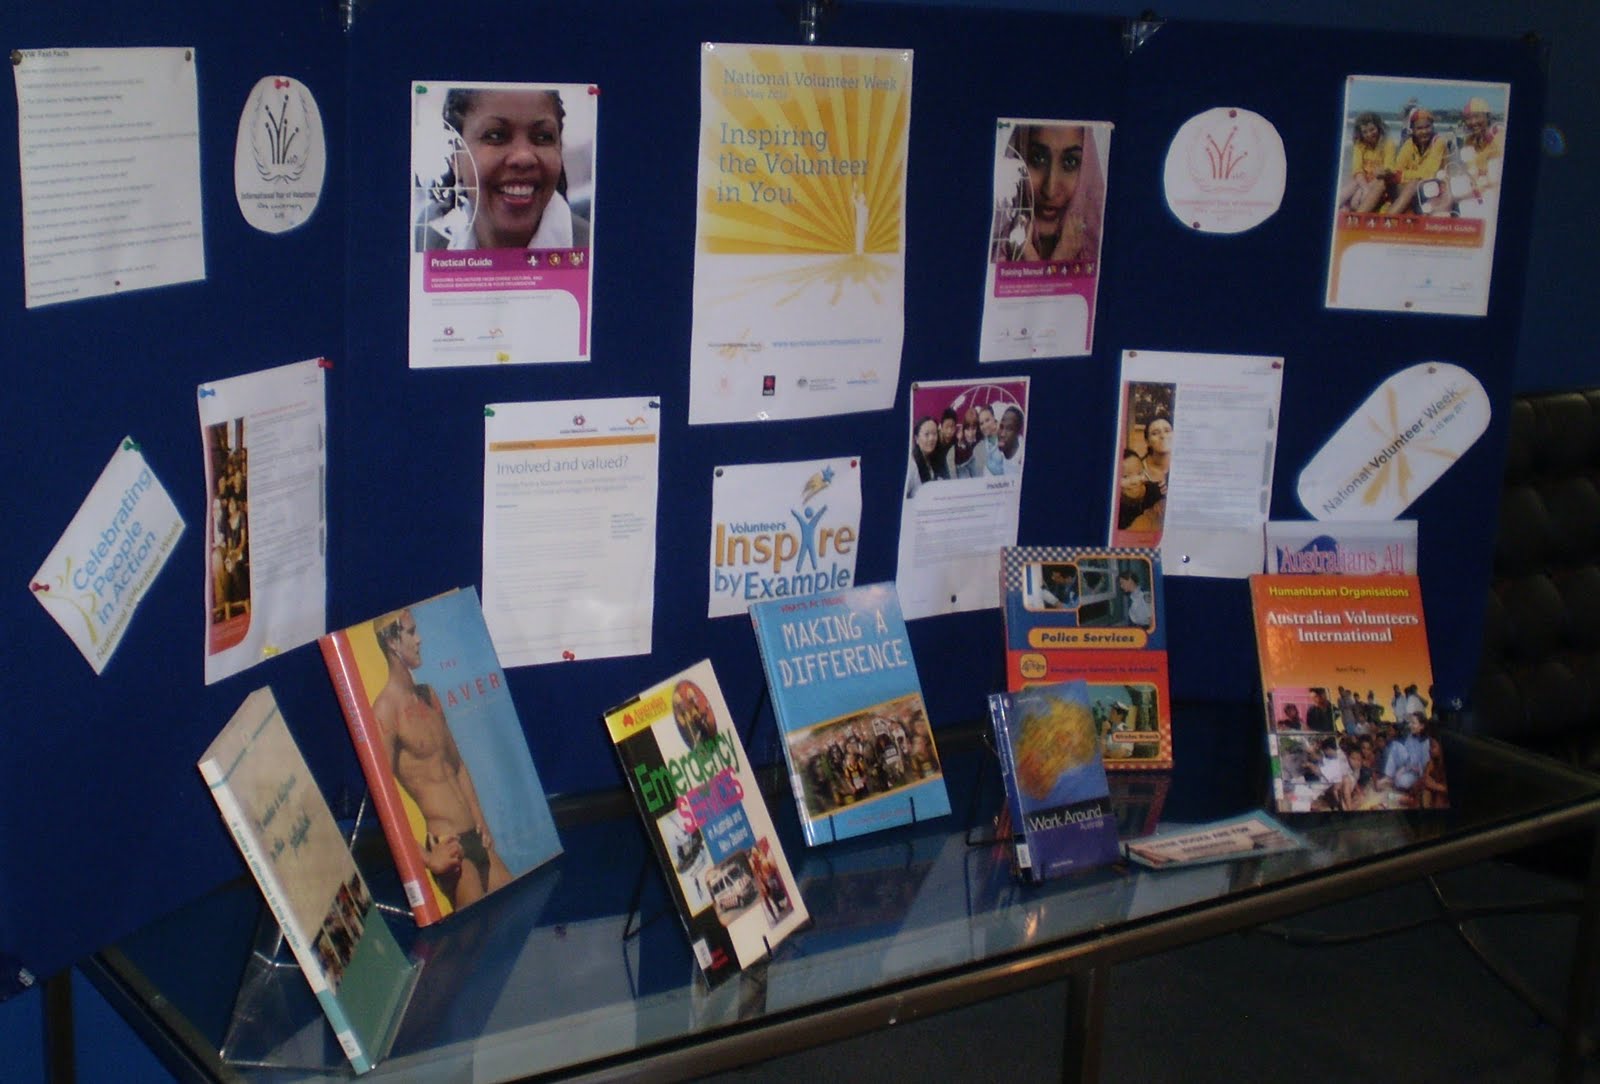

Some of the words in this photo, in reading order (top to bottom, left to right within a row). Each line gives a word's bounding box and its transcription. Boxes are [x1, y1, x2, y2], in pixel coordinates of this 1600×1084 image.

[724, 68, 789, 87] National
[794, 71, 859, 88] Volunteer
[864, 75, 897, 90] Week
[720, 122, 828, 151] Inspiring
[719, 152, 757, 174] the
[766, 153, 869, 176] Volunteer
[717, 181, 740, 203] in
[431, 258, 466, 267] Practical
[467, 257, 493, 267] Guide
[497, 459, 550, 475] Involved
[553, 458, 577, 472] and
[581, 455, 629, 471] valued?
[1322, 466, 1371, 514] National
[1369, 417, 1425, 470] Volunteer
[1423, 387, 1458, 419] Week
[72, 466, 153, 590] Celebrating
[730, 521, 786, 534] Volunteers
[92, 519, 143, 599] People
[1280, 543, 1377, 574] Australians
[1381, 543, 1405, 574] All
[96, 601, 115, 625] in
[113, 530, 156, 599] Action
[714, 568, 742, 597] by
[744, 562, 850, 601] Example
[1269, 586, 1337, 597] Humanitarian
[1340, 586, 1409, 599] Organisations
[782, 611, 862, 652] MAKING
[875, 608, 889, 634] A
[1266, 610, 1341, 626] Australian
[1344, 610, 1419, 626] Volunteers
[95, 611, 128, 661] National
[1041, 632, 1079, 643] Police
[1083, 632, 1135, 643] Services
[1298, 628, 1393, 643] International
[778, 638, 908, 688] DIFFERENCE
[633, 728, 740, 813] Emergency
[1029, 816, 1063, 833] Work
[1063, 804, 1102, 826] Around
